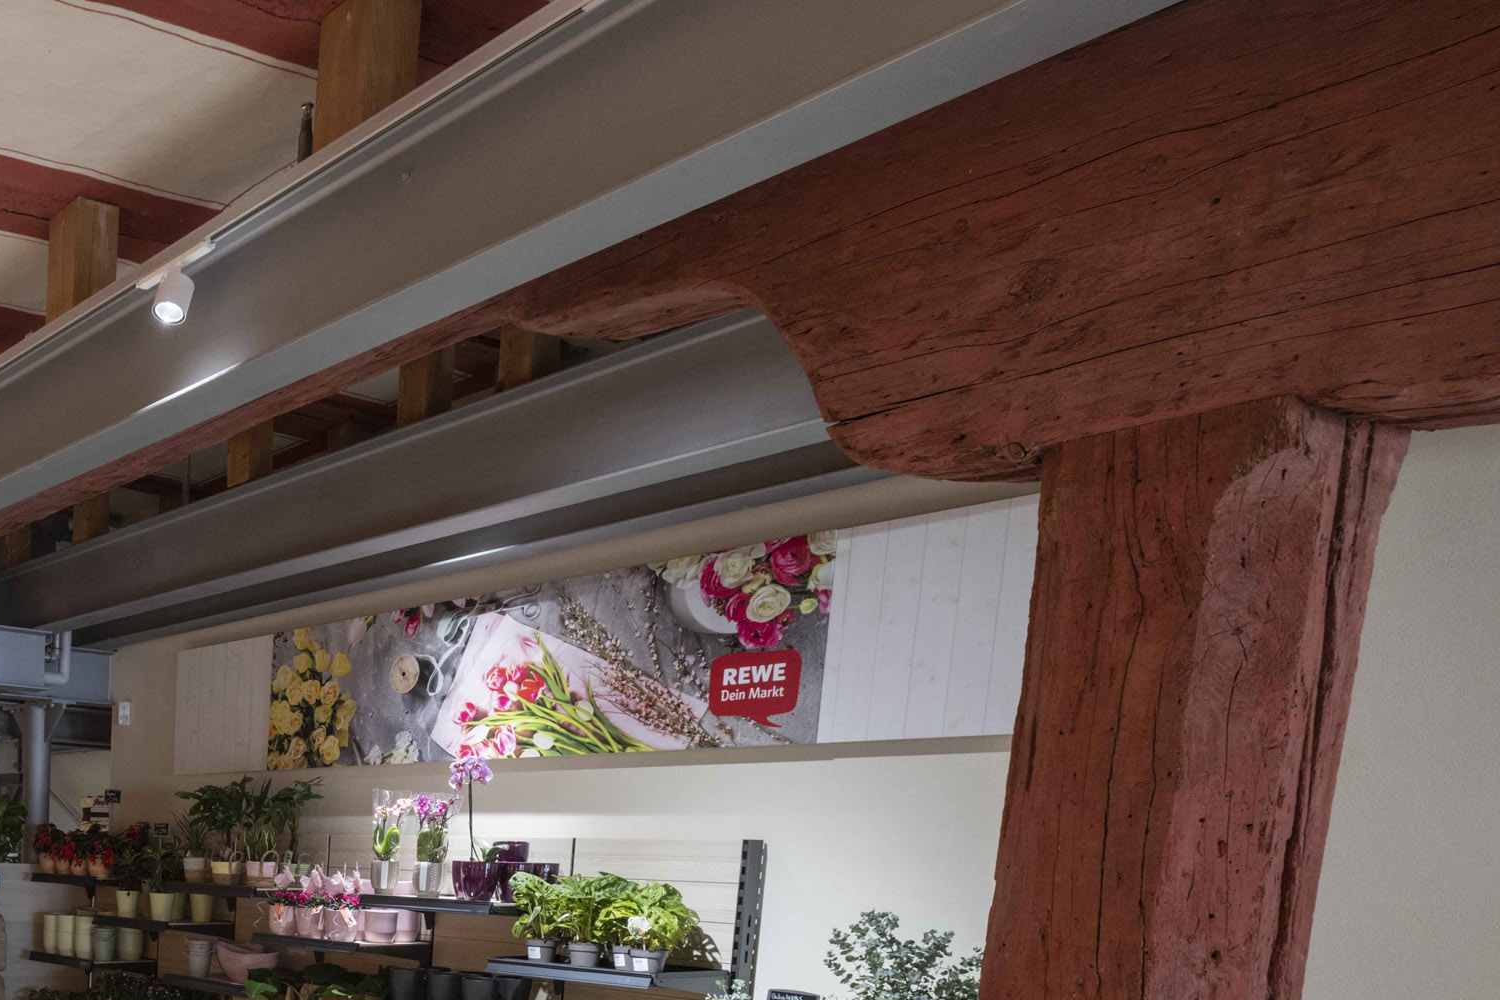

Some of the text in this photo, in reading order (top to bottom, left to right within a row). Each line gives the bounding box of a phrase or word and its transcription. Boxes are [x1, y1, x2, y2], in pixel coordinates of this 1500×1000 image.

[722, 662, 786, 686] REWE
[721, 685, 784, 702] Dein Markt
